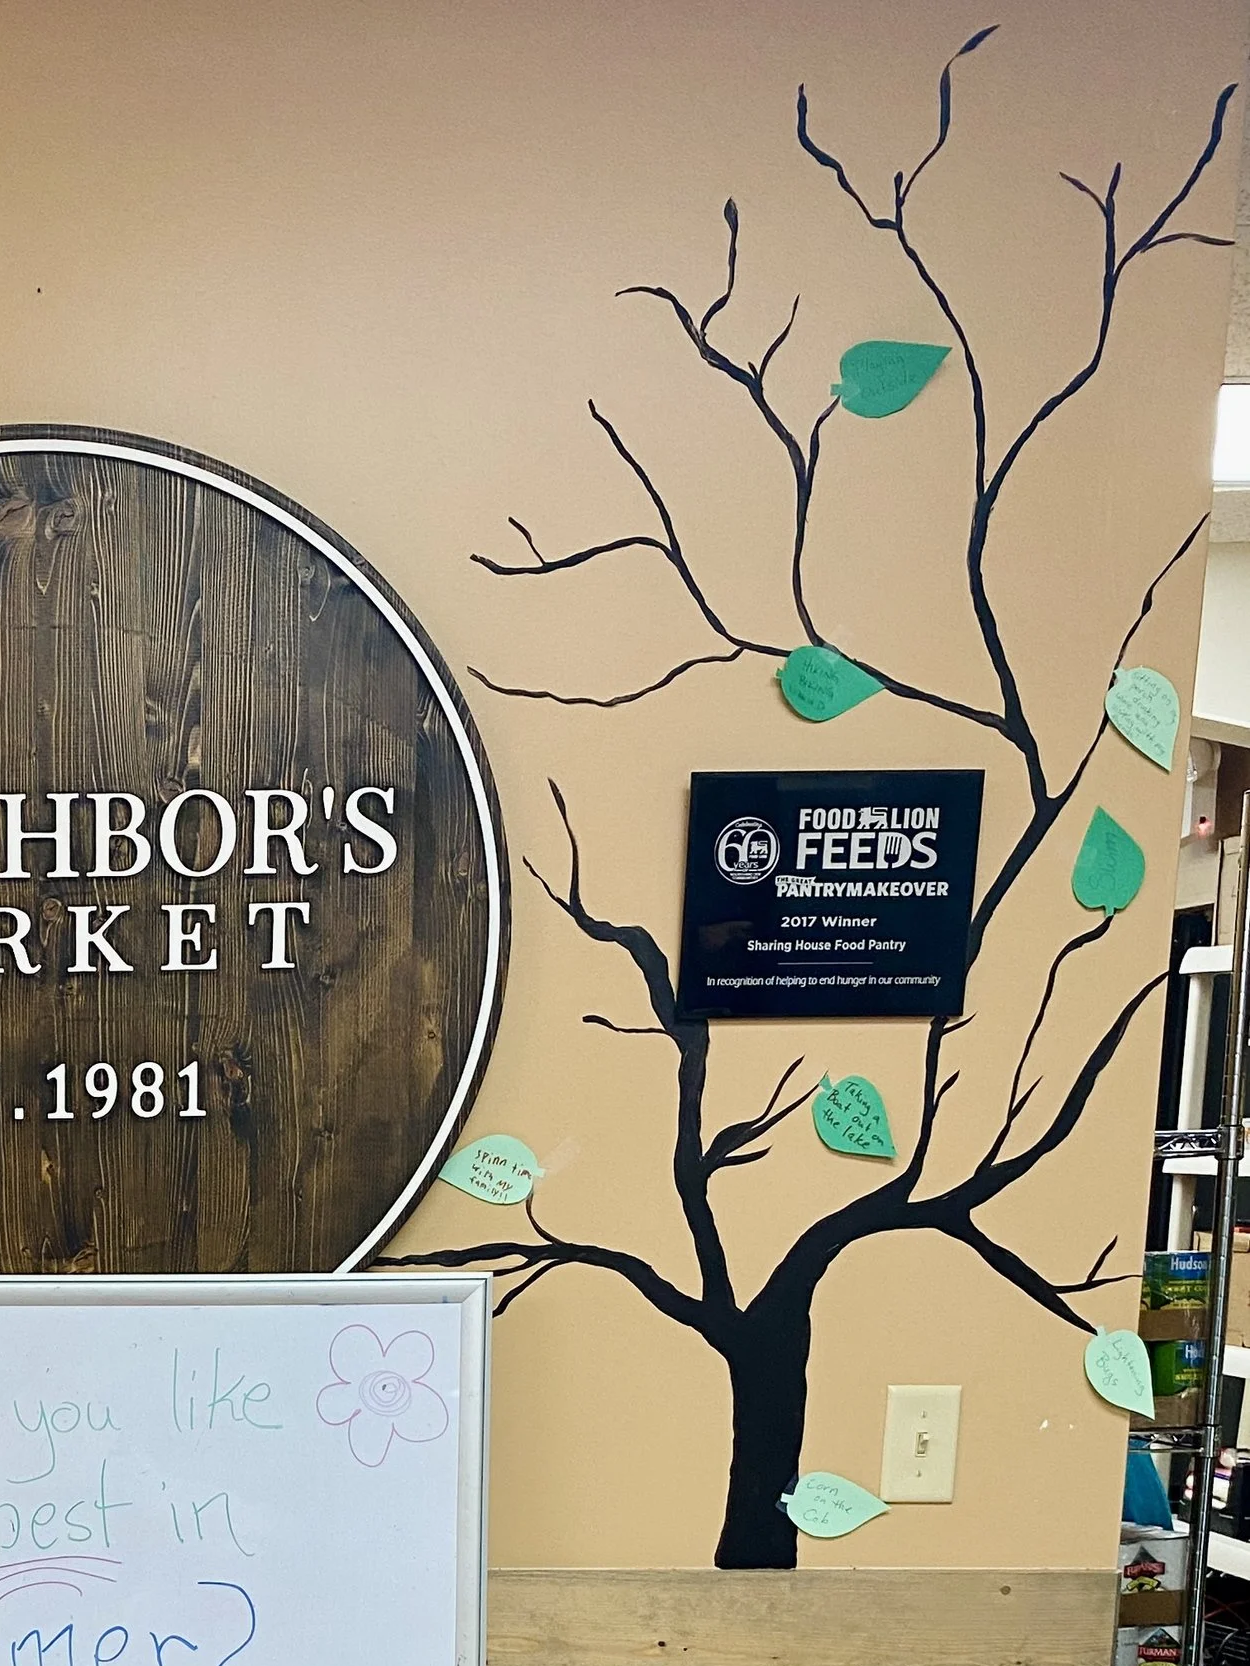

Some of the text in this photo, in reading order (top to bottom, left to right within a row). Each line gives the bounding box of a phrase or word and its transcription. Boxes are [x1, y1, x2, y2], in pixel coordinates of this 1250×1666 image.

[799, 806, 940, 830] FOOD LION
[796, 831, 938, 870] FEEDS
[780, 915, 877, 928] 2017 Winner
[747, 939, 906, 952] Sharing House Food Pantry
[707, 975, 941, 988] In recognition of helping to end hunger in our community
[12, 1396, 118, 1485] you
[171, 1348, 283, 1433] like
[160, 1479, 255, 1558] in
